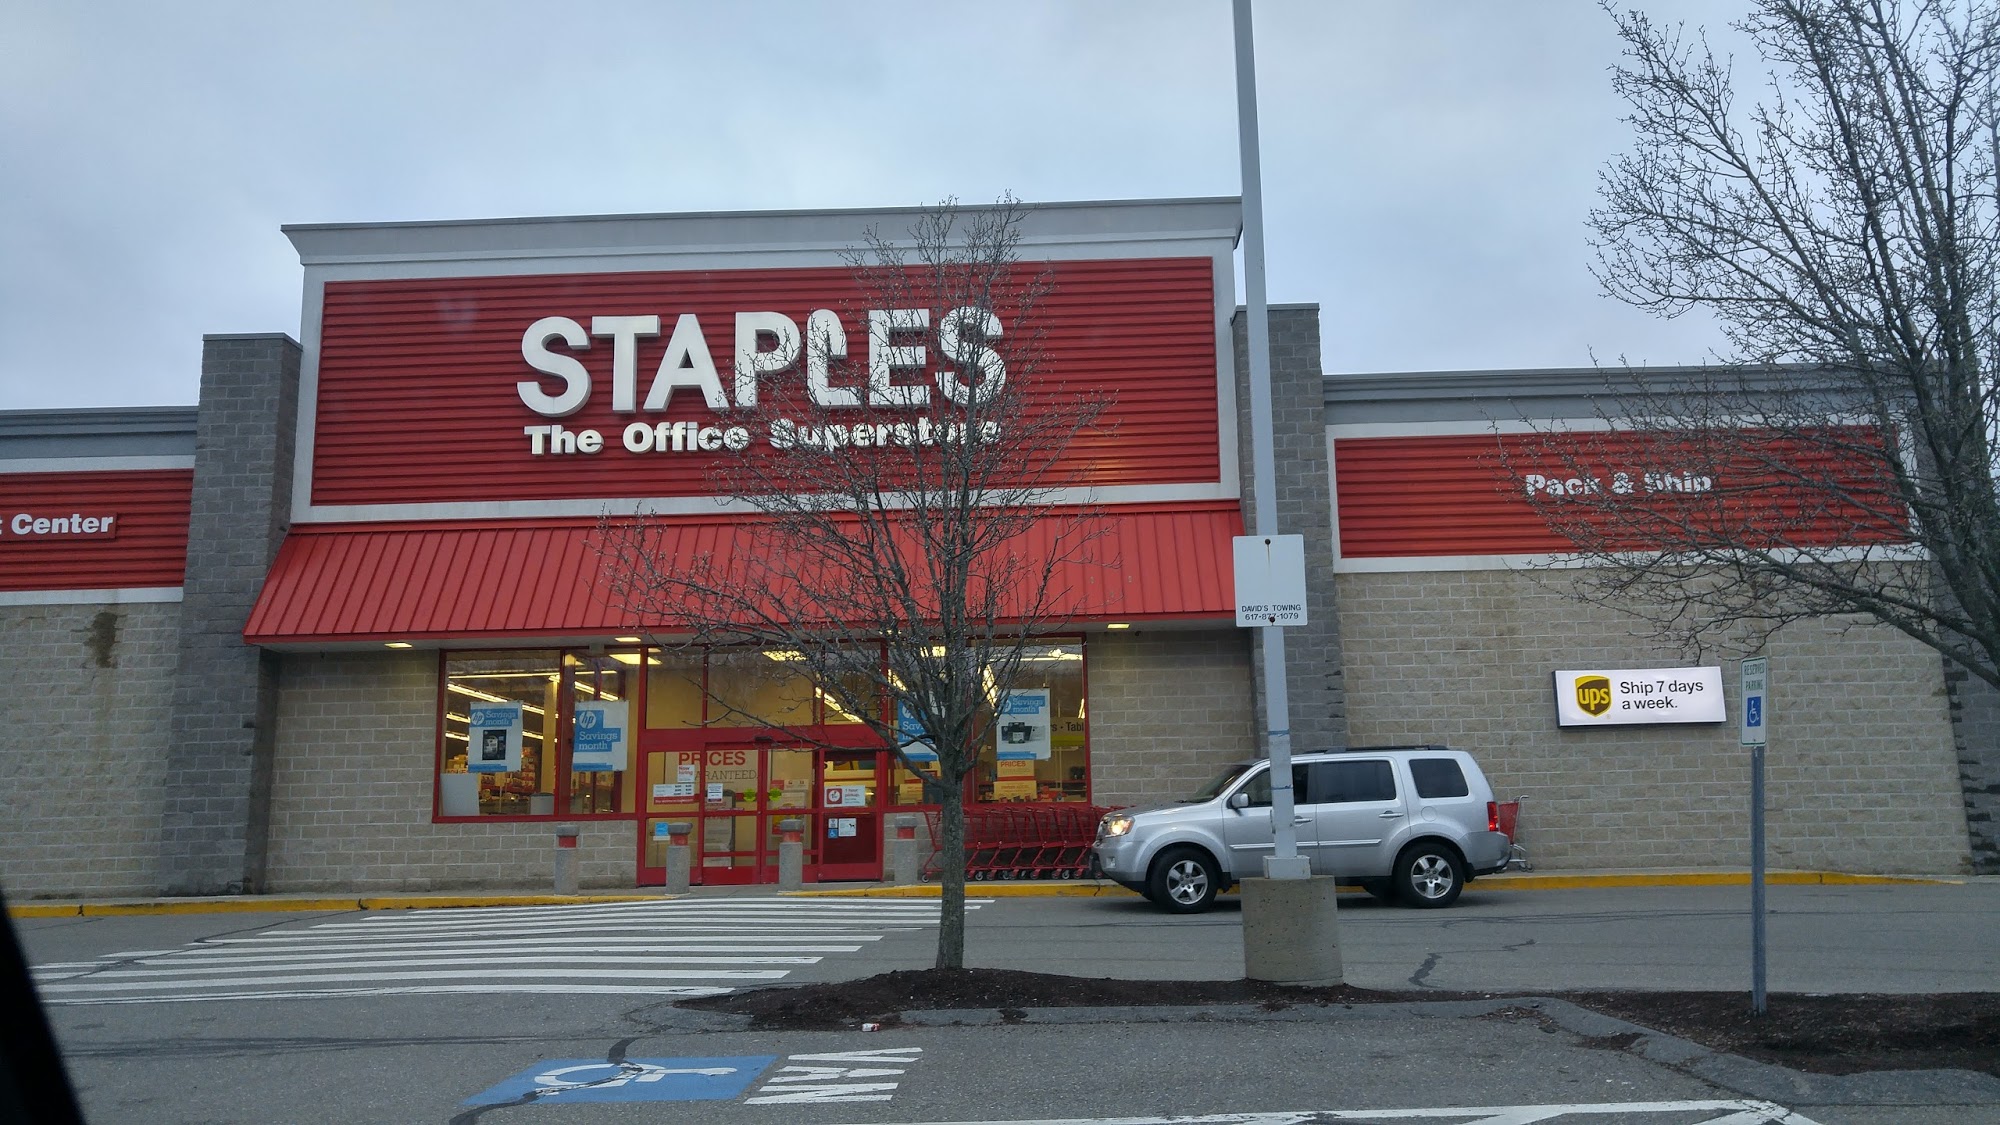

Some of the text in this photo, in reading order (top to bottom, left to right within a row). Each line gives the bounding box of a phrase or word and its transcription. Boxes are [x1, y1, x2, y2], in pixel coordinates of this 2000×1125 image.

[517, 307, 1006, 417] STAPLES
[524, 424, 604, 455] The
[622, 421, 751, 453] Office
[1525, 471, 1712, 498] Pack & Ship
[11, 513, 114, 535] Center
[1744, 662, 1765, 676] RESERVED
[1620, 680, 1704, 697] Ship 7 days
[1745, 680, 1763, 691] PARKING
[1013, 698, 1043, 707] Savings
[1578, 688, 1610, 711] ups
[1622, 697, 1678, 710] a week.
[472, 711, 485, 725] hp
[486, 711, 516, 720] Savings
[579, 731, 618, 742] Savings
[578, 741, 608, 750] month
[1001, 760, 1027, 768] PRICES
